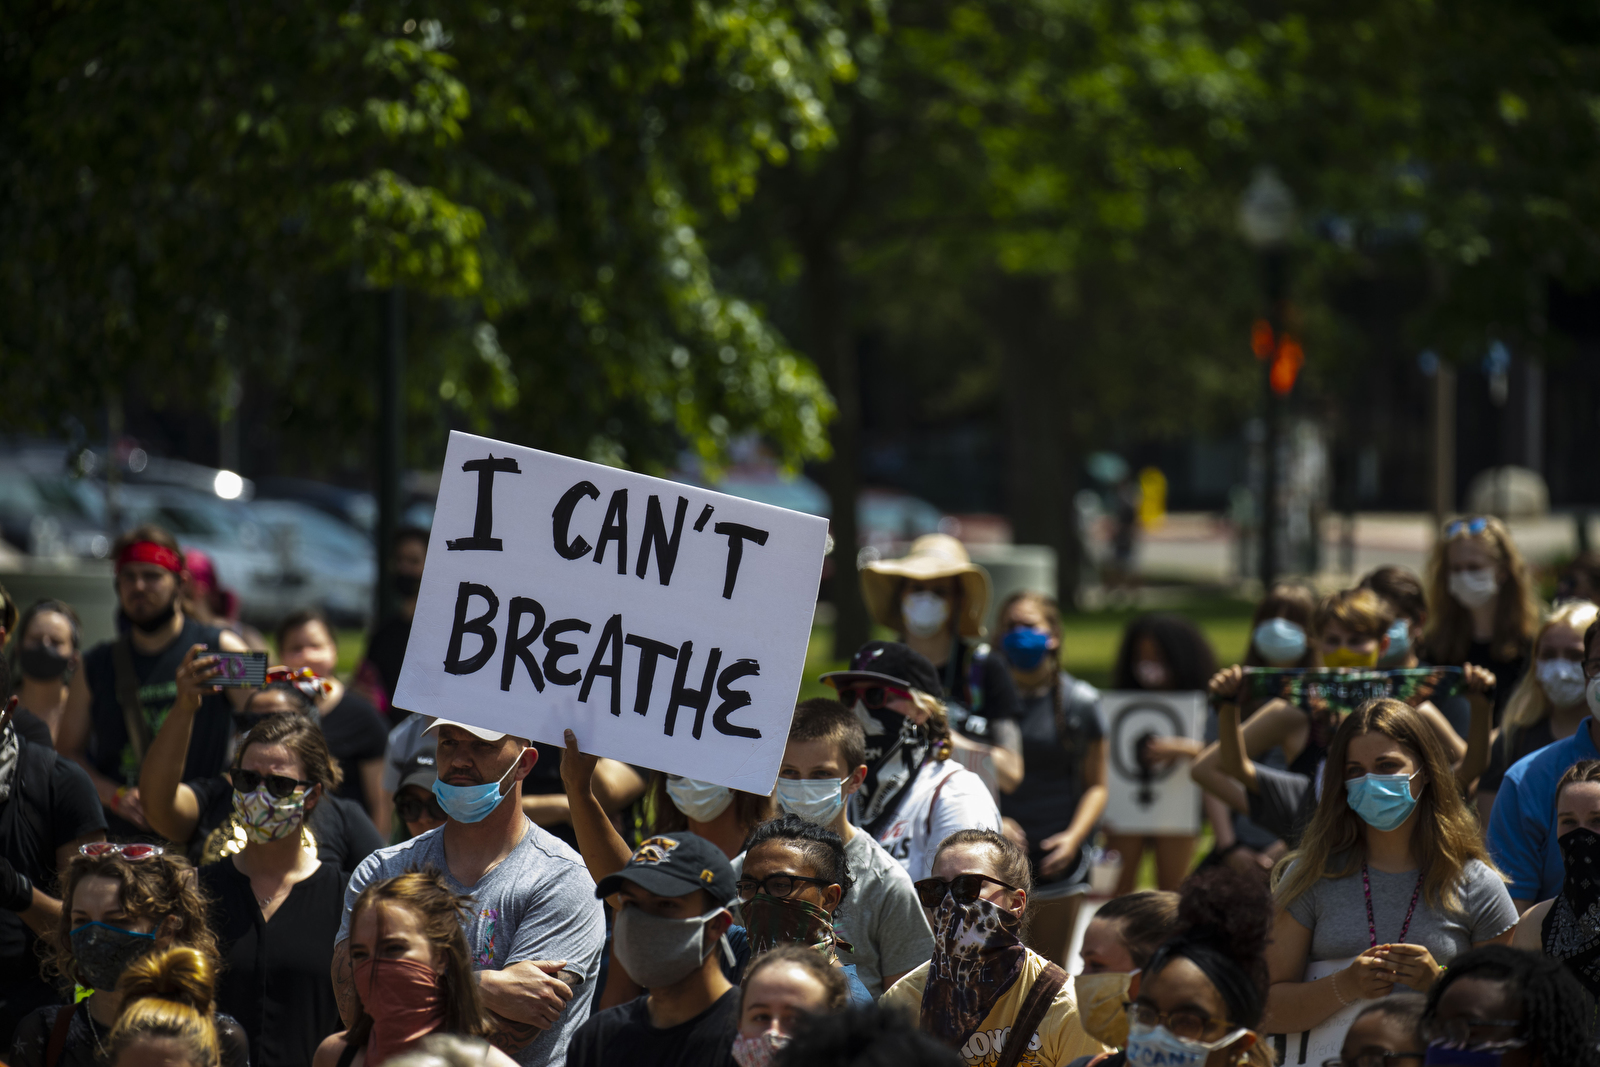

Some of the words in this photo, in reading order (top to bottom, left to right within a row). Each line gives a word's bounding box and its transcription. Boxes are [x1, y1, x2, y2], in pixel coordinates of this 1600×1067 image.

[446, 453, 521, 551] I
[552, 480, 769, 599] CAN'T
[443, 581, 762, 740] BREATHE
